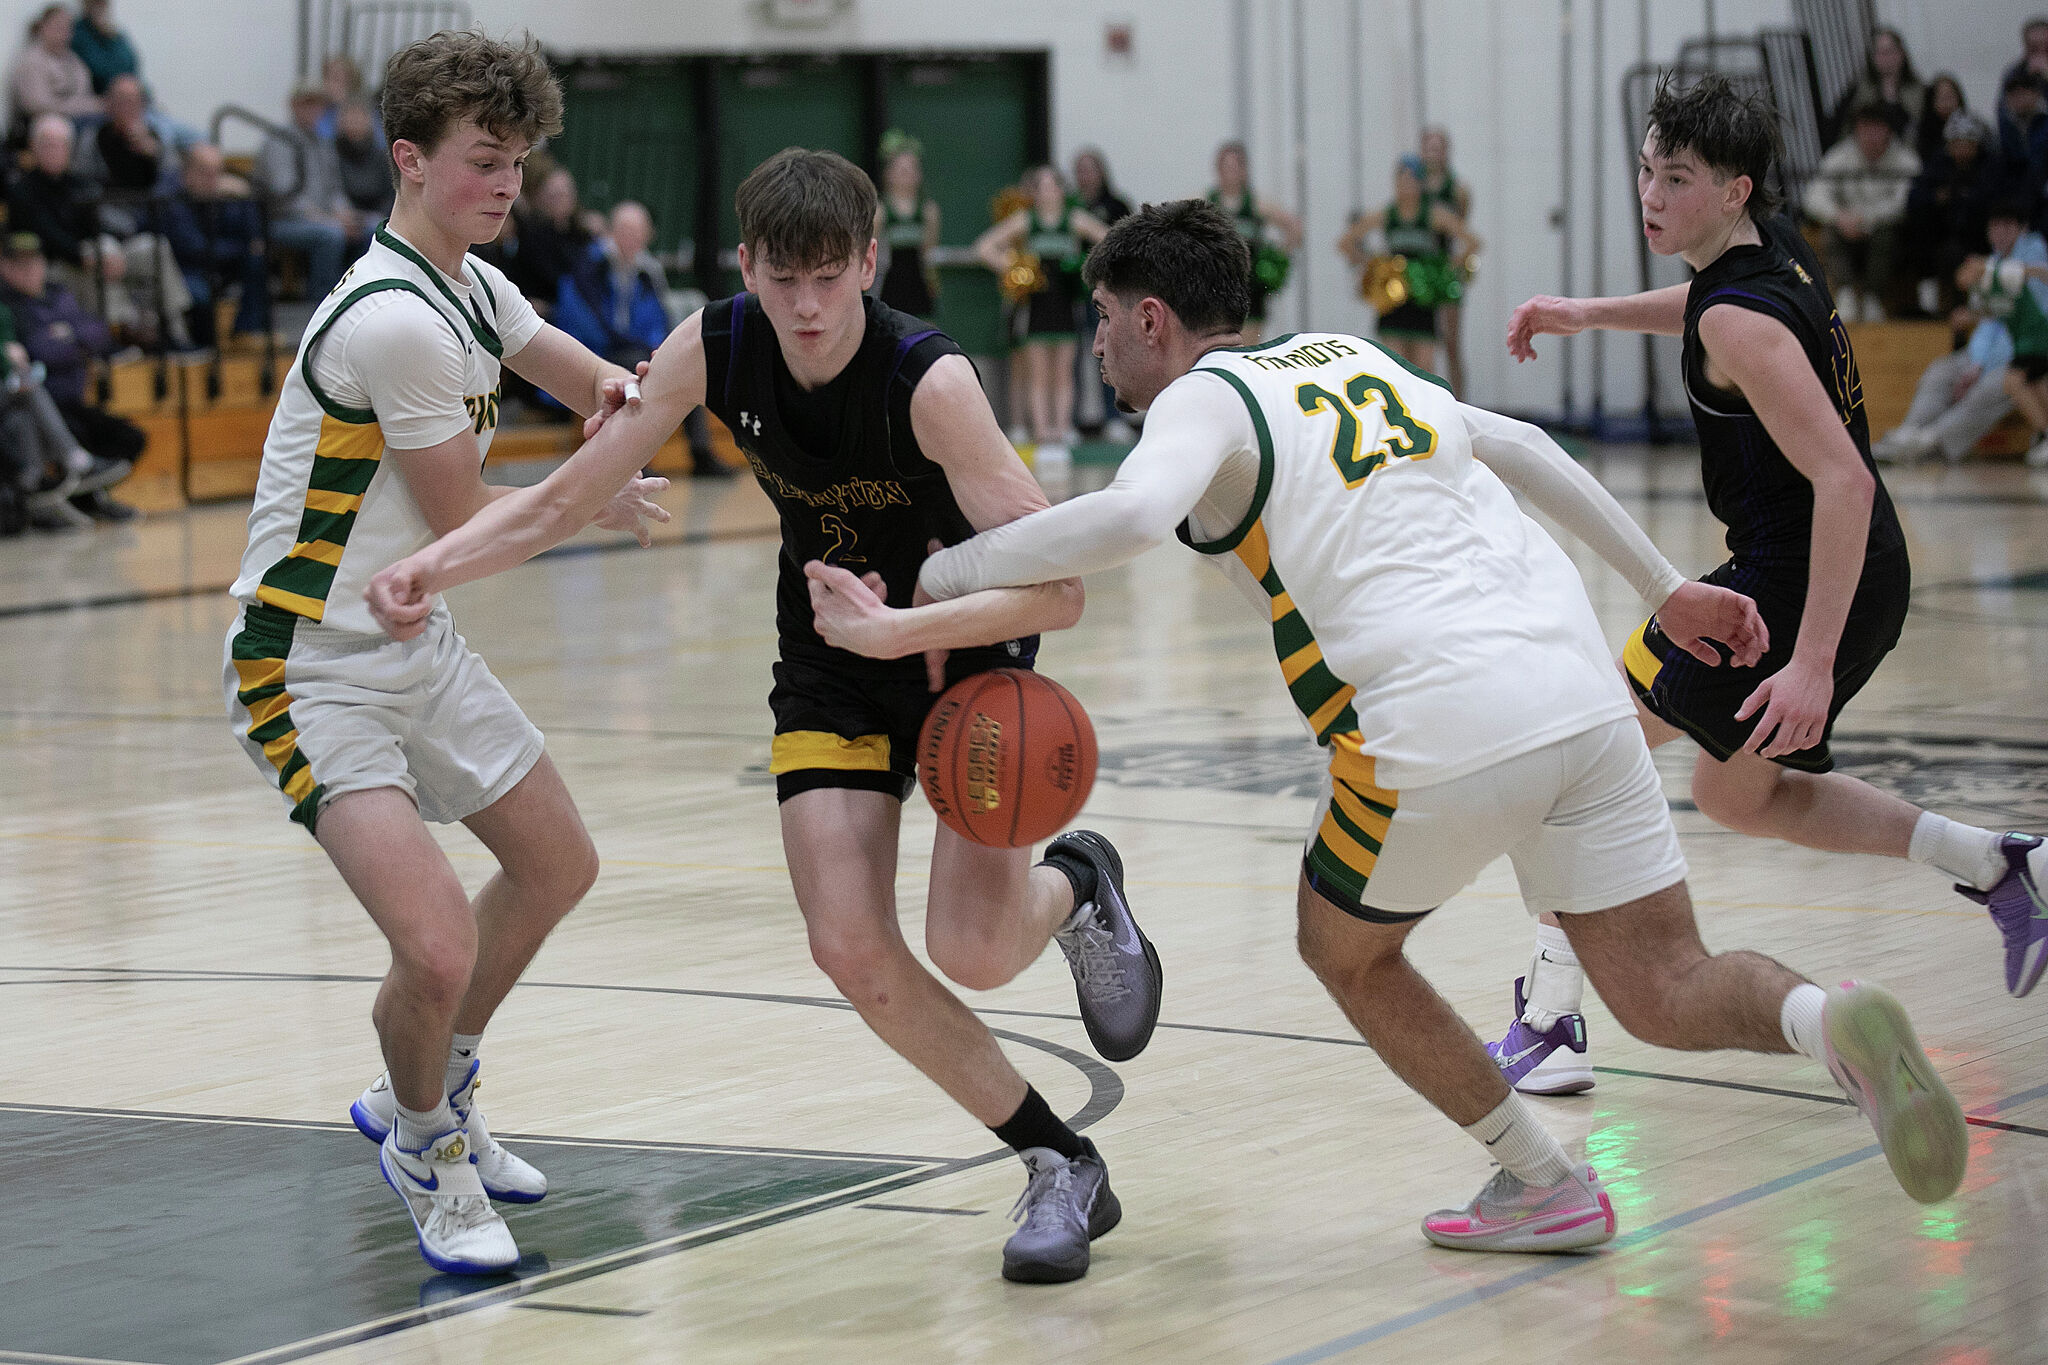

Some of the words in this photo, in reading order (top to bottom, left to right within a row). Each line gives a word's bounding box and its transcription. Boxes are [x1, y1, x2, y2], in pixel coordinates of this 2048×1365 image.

[1295, 372, 1439, 490] 23
[820, 513, 868, 565] 2
[927, 700, 960, 818] SPALDING
[967, 712, 991, 815] LEGACY
